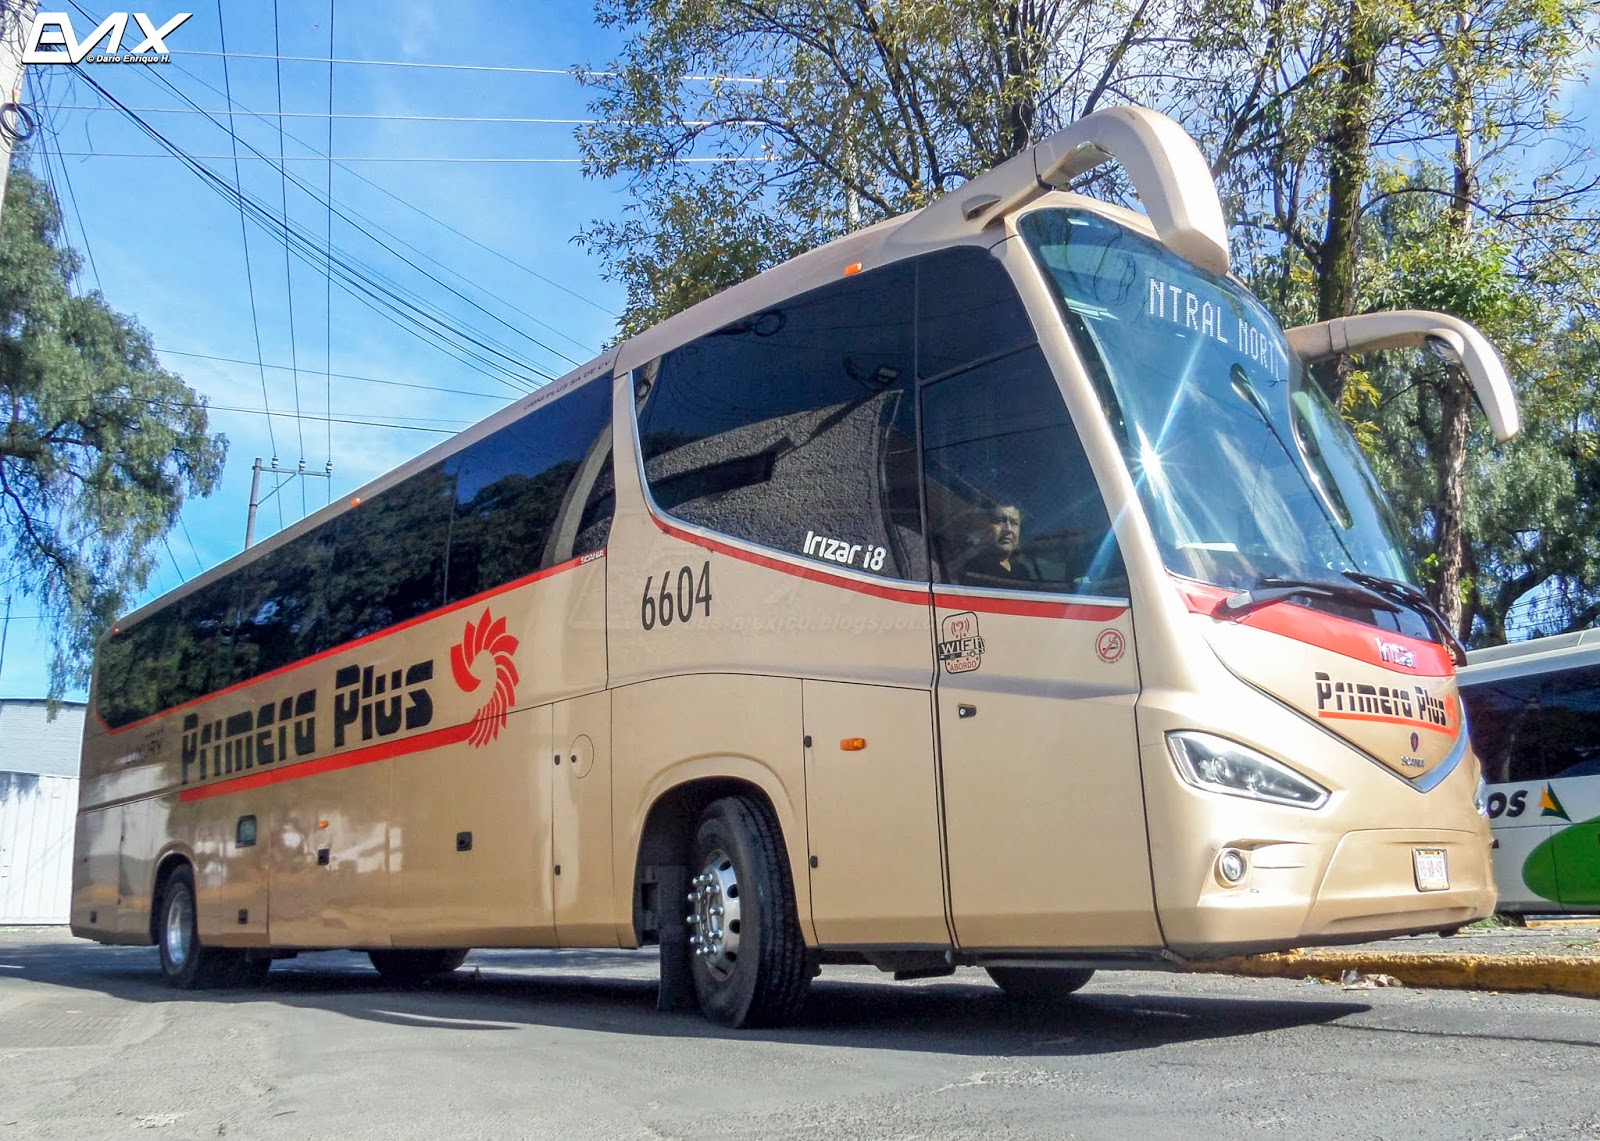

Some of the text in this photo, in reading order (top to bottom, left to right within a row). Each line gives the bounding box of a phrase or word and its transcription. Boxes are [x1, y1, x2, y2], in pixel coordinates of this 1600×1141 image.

[580, 549, 605, 564] SCANIA
[803, 530, 887, 571] Irizar i8
[641, 560, 713, 631] 6604
[941, 638, 977, 655] WIFI
[950, 660, 978, 672] ABORDO
[1314, 671, 1446, 727] Primera Plus
[181, 659, 434, 785] Primera Plus
[1401, 756, 1424, 768] SCANIA
